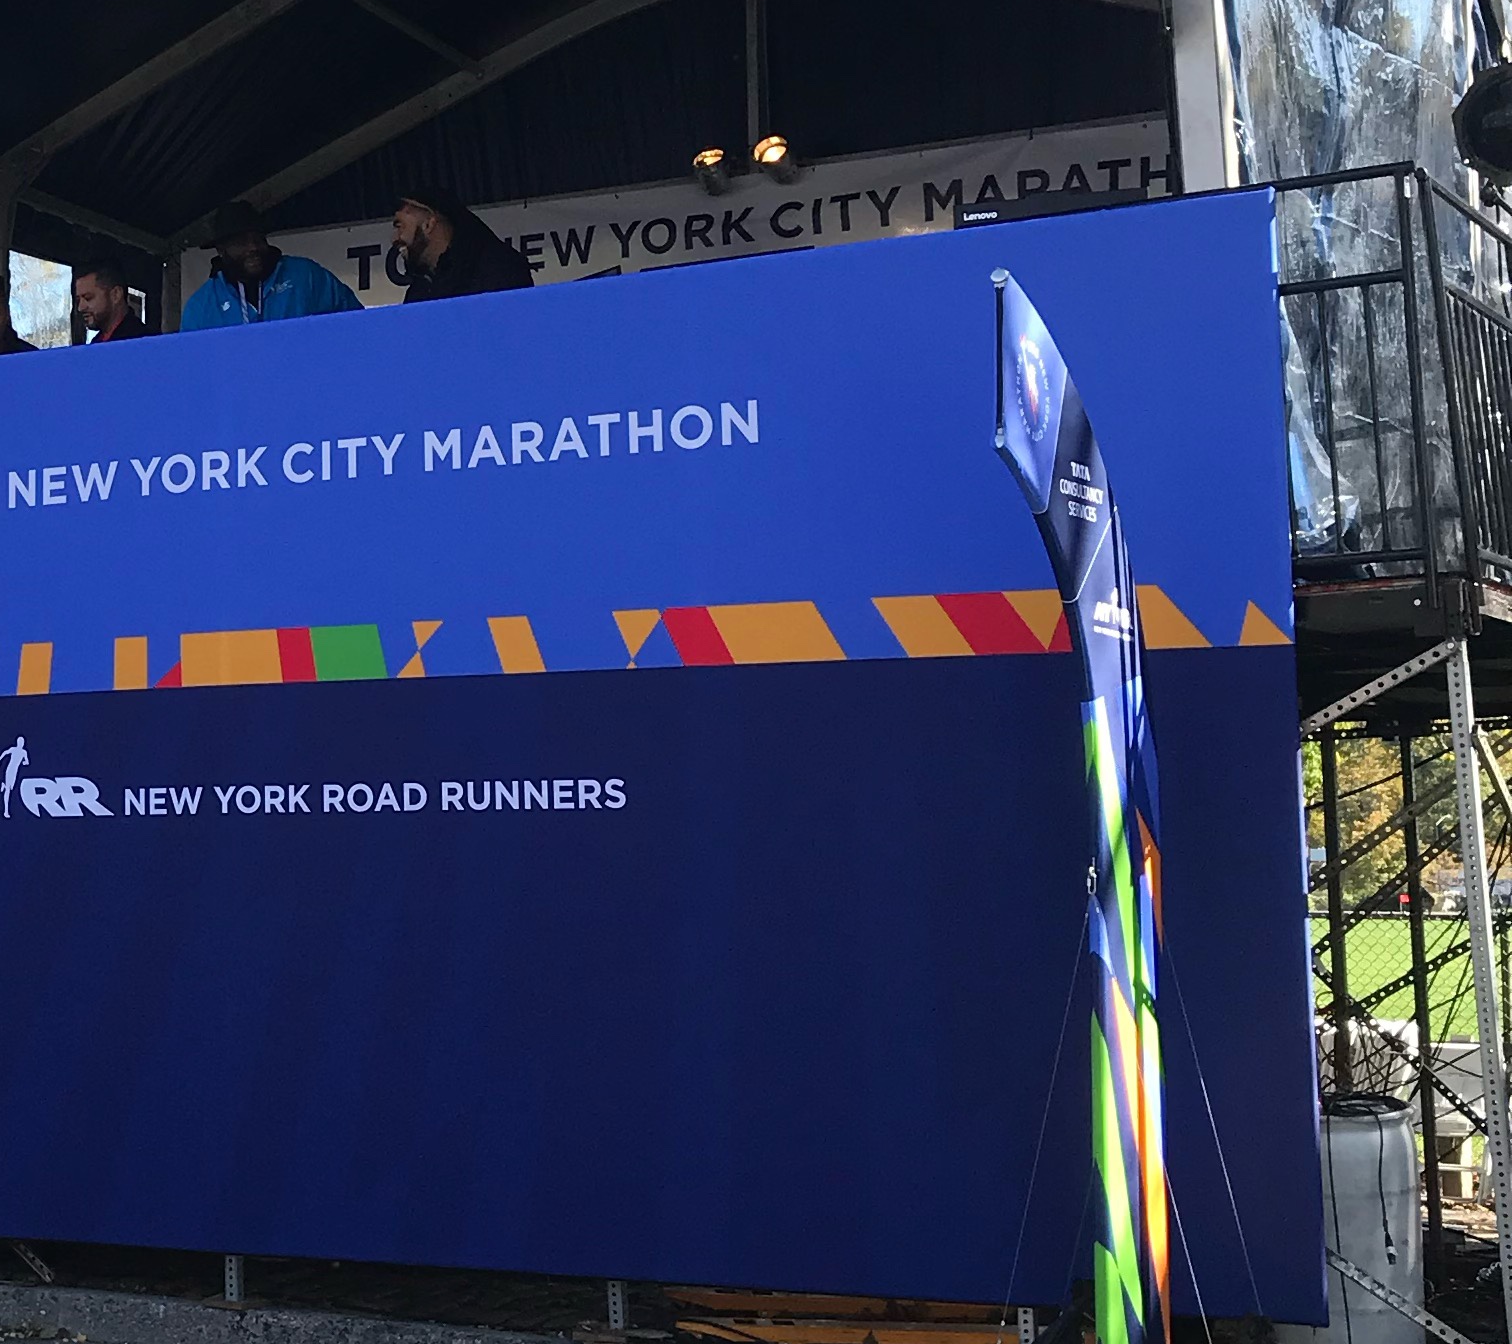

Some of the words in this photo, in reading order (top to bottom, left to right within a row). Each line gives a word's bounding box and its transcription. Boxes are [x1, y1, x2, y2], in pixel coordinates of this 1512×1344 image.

[347, 244, 412, 290] TC
[504, 225, 596, 271] EW
[608, 206, 755, 259] YORK
[769, 185, 901, 239] CITY
[923, 153, 1173, 222] MARATH
[962, 210, 998, 222] Lenovo
[7, 460, 119, 509] NEW
[129, 446, 269, 497] YORK
[282, 433, 406, 484] CITY
[423, 399, 760, 472] MARATHON
[124, 787, 203, 816] NEW
[214, 784, 311, 815] YORK
[322, 782, 428, 814] ROAD
[441, 778, 628, 812] RUNNERS
